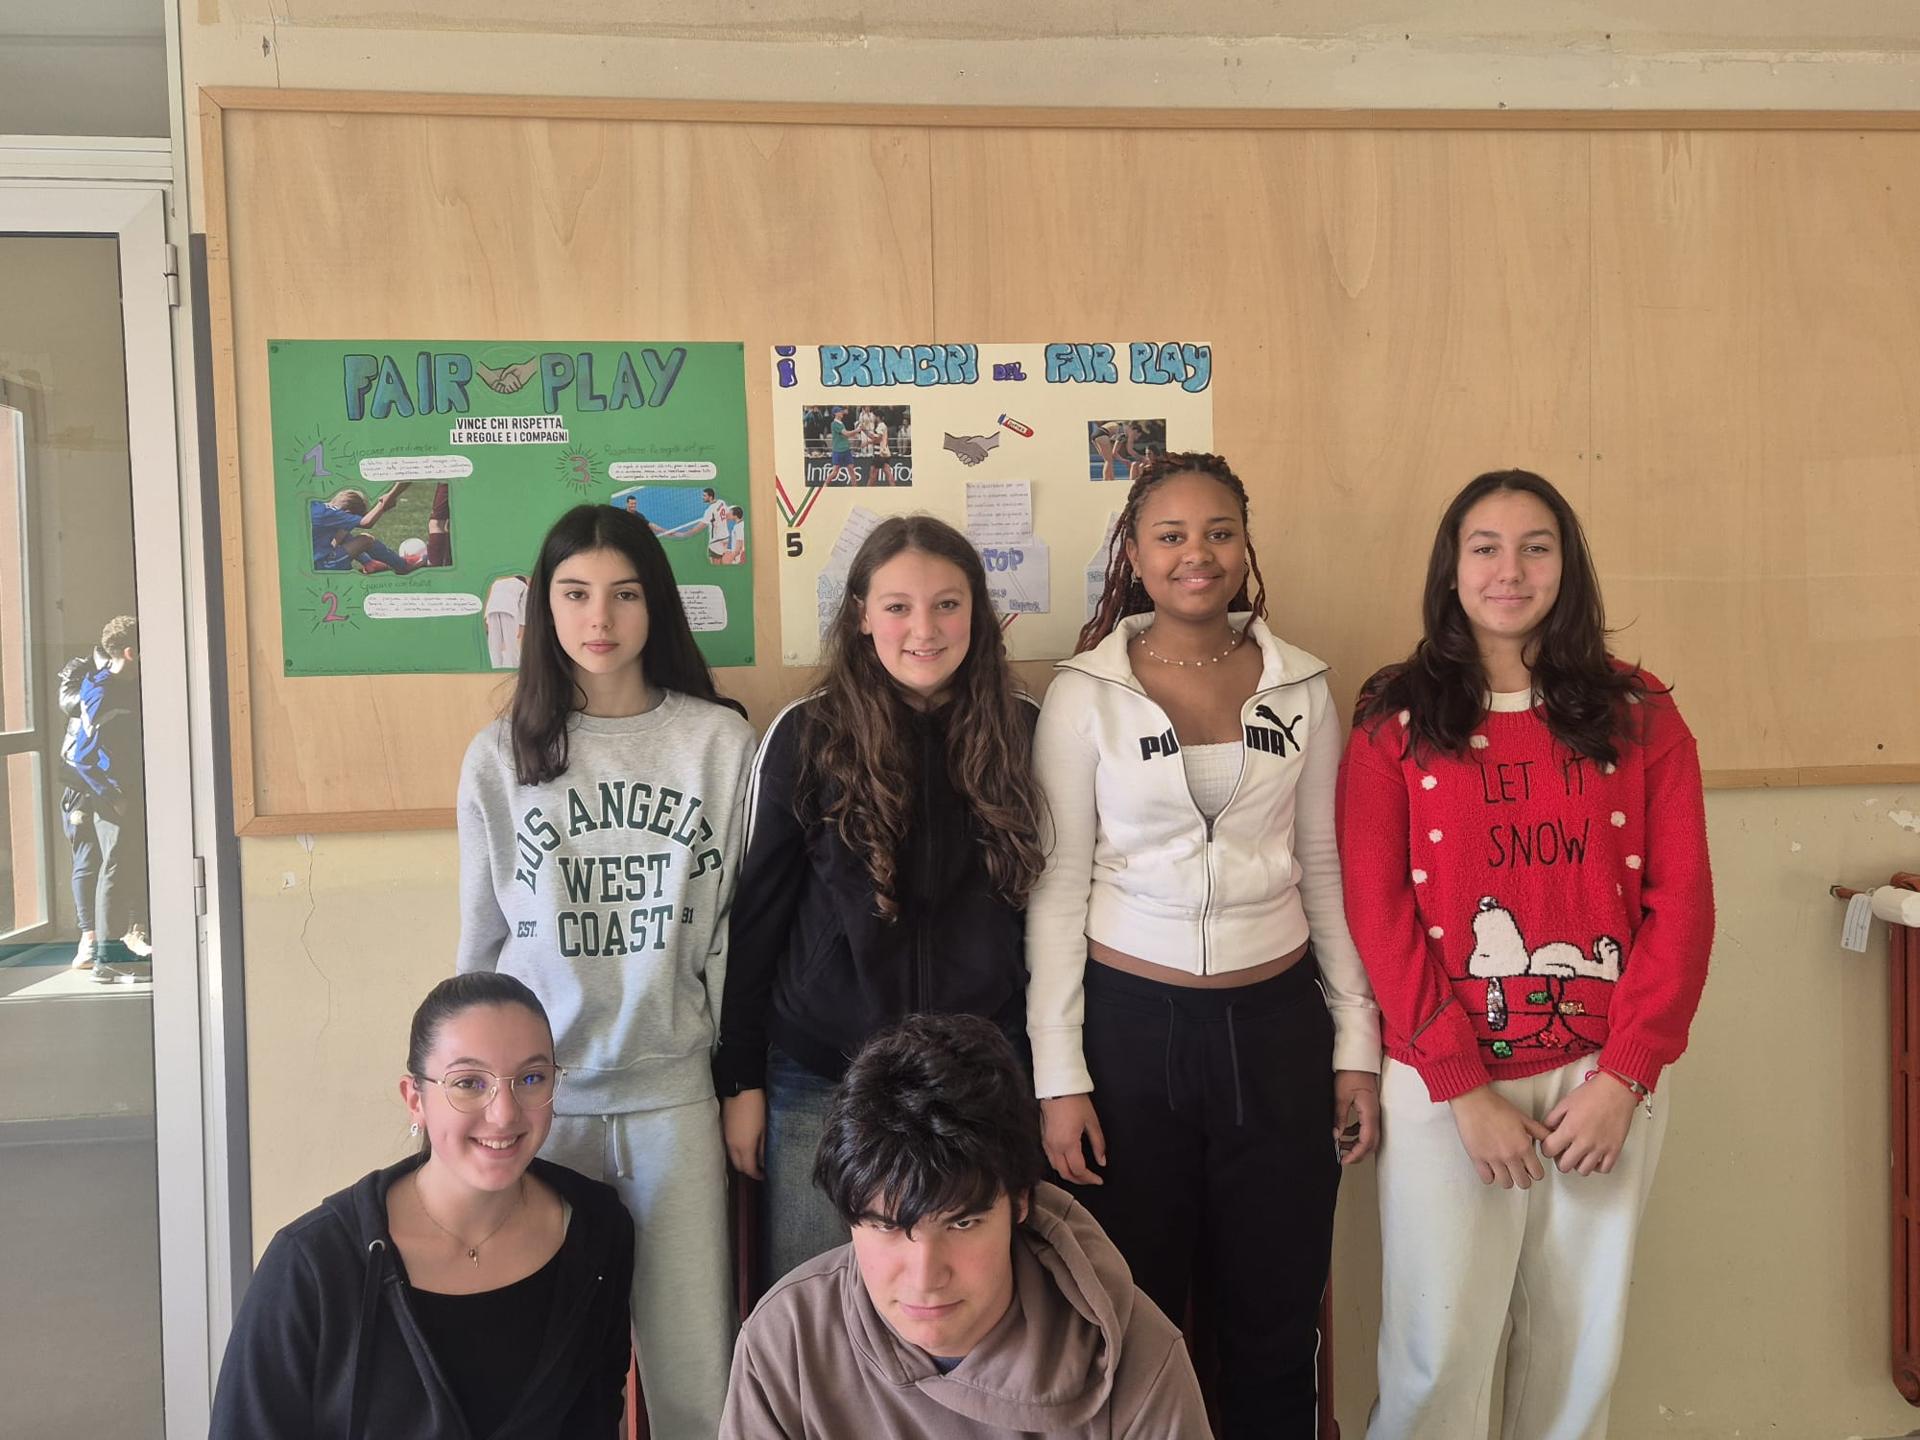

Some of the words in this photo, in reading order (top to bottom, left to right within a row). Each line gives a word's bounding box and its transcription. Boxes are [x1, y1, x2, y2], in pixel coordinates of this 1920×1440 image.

[344, 352, 472, 420] FAIR
[540, 348, 687, 414] PLAY
[818, 344, 979, 386] PRINCIPI
[1045, 343, 1118, 384] FAIR
[1129, 342, 1211, 393] PLAY
[452, 432, 463, 442] LE
[467, 432, 502, 442] REGOLE
[506, 432, 511, 442] E
[520, 431, 568, 442] COMPAGNI
[457, 419, 487, 429] VINCE
[491, 418, 508, 429] CHI
[512, 417, 562, 429] RISPETTA
[303, 441, 332, 476] 1
[569, 455, 590, 483] 3
[878, 463, 912, 482] Info
[786, 532, 804, 557] 5
[981, 547, 1024, 572] TOP
[321, 592, 349, 622] 2
[1480, 761, 1534, 803] LET
[1563, 756, 1586, 796] IT
[515, 807, 561, 895] LOS
[1488, 817, 1590, 868] SNOW
[558, 853, 671, 903] WEST
[557, 904, 673, 957] COAST
